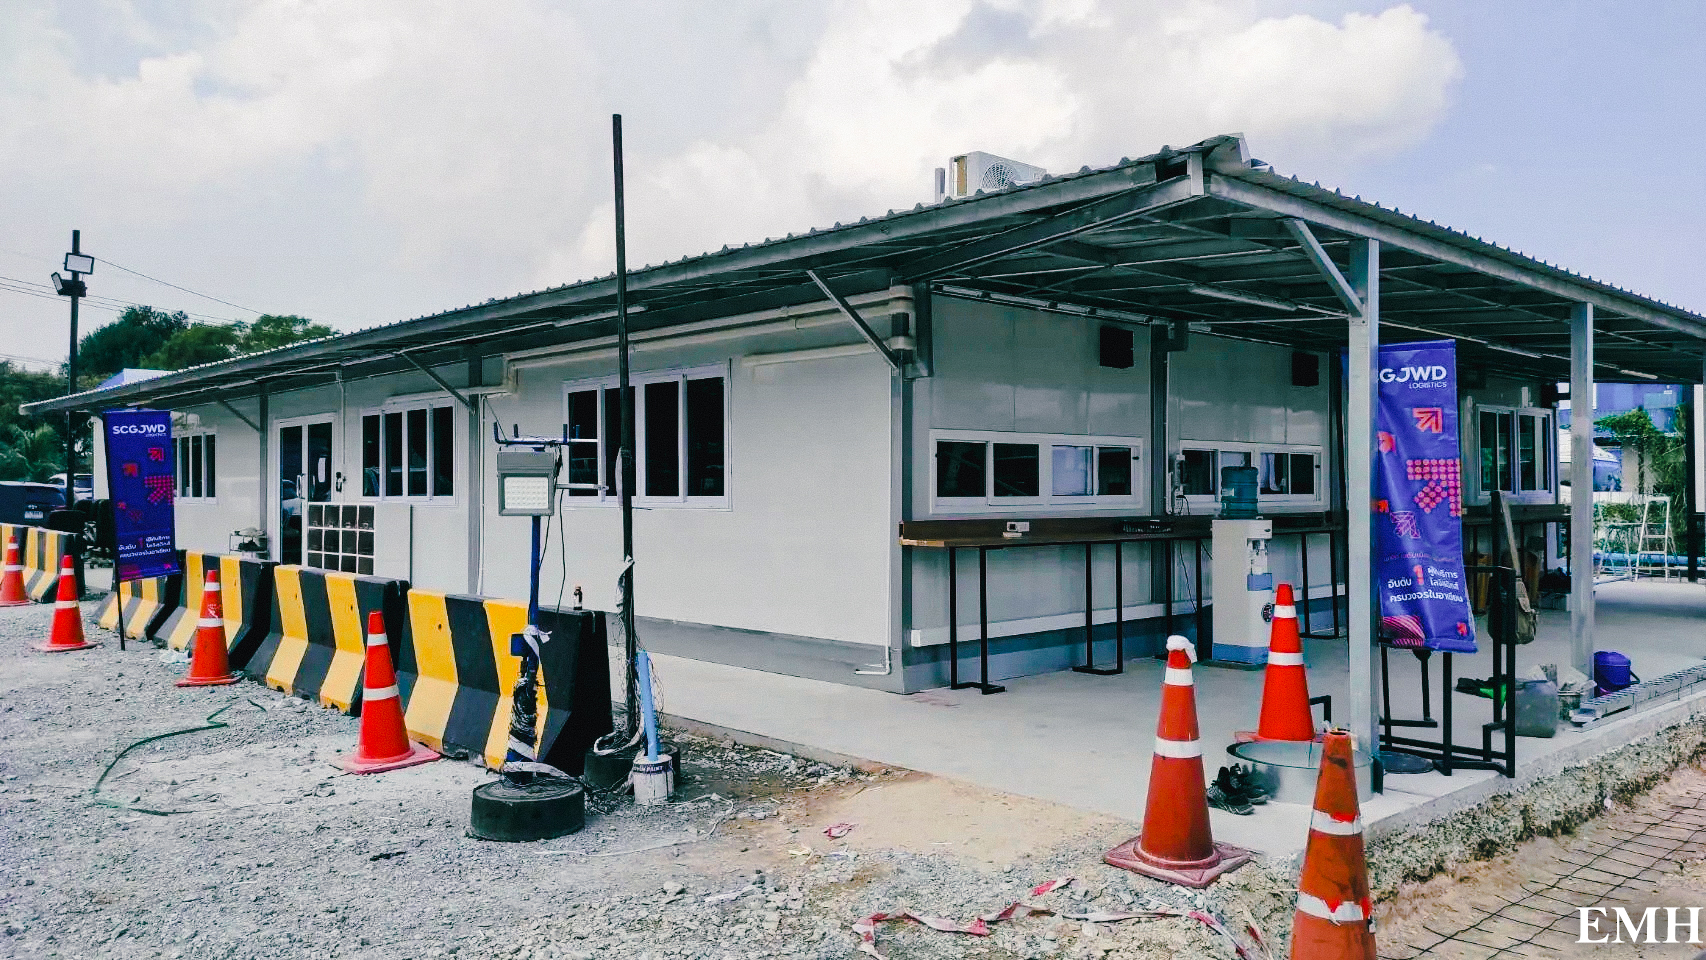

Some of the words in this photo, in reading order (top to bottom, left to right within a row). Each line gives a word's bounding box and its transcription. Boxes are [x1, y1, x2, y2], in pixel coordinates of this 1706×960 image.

[1379, 365, 1447, 383] GJWD
[112, 423, 166, 435] SCGJWD
[1387, 576, 1412, 589] อันดับ
